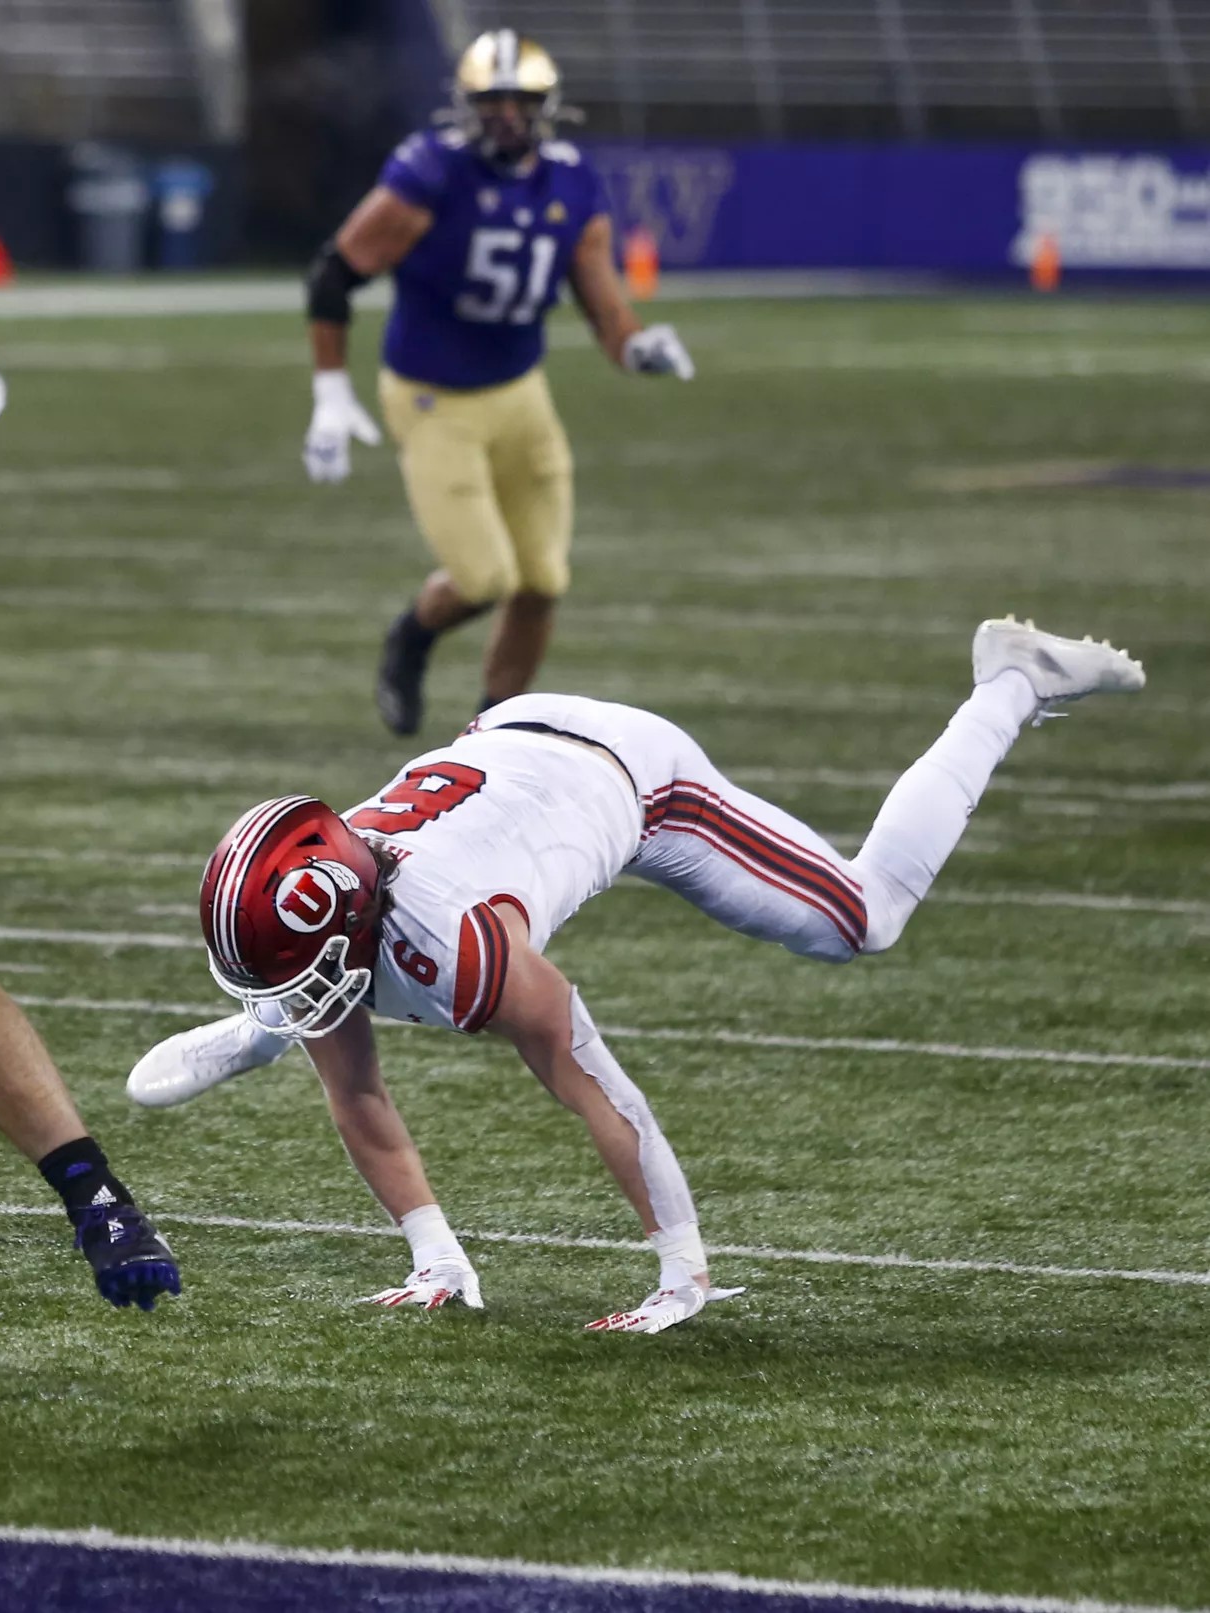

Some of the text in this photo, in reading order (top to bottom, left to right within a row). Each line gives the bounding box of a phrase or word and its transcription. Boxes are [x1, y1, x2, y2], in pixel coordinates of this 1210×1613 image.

[454, 227, 558, 325] 51
[279, 871, 333, 926] U
[393, 940, 439, 987] 6
